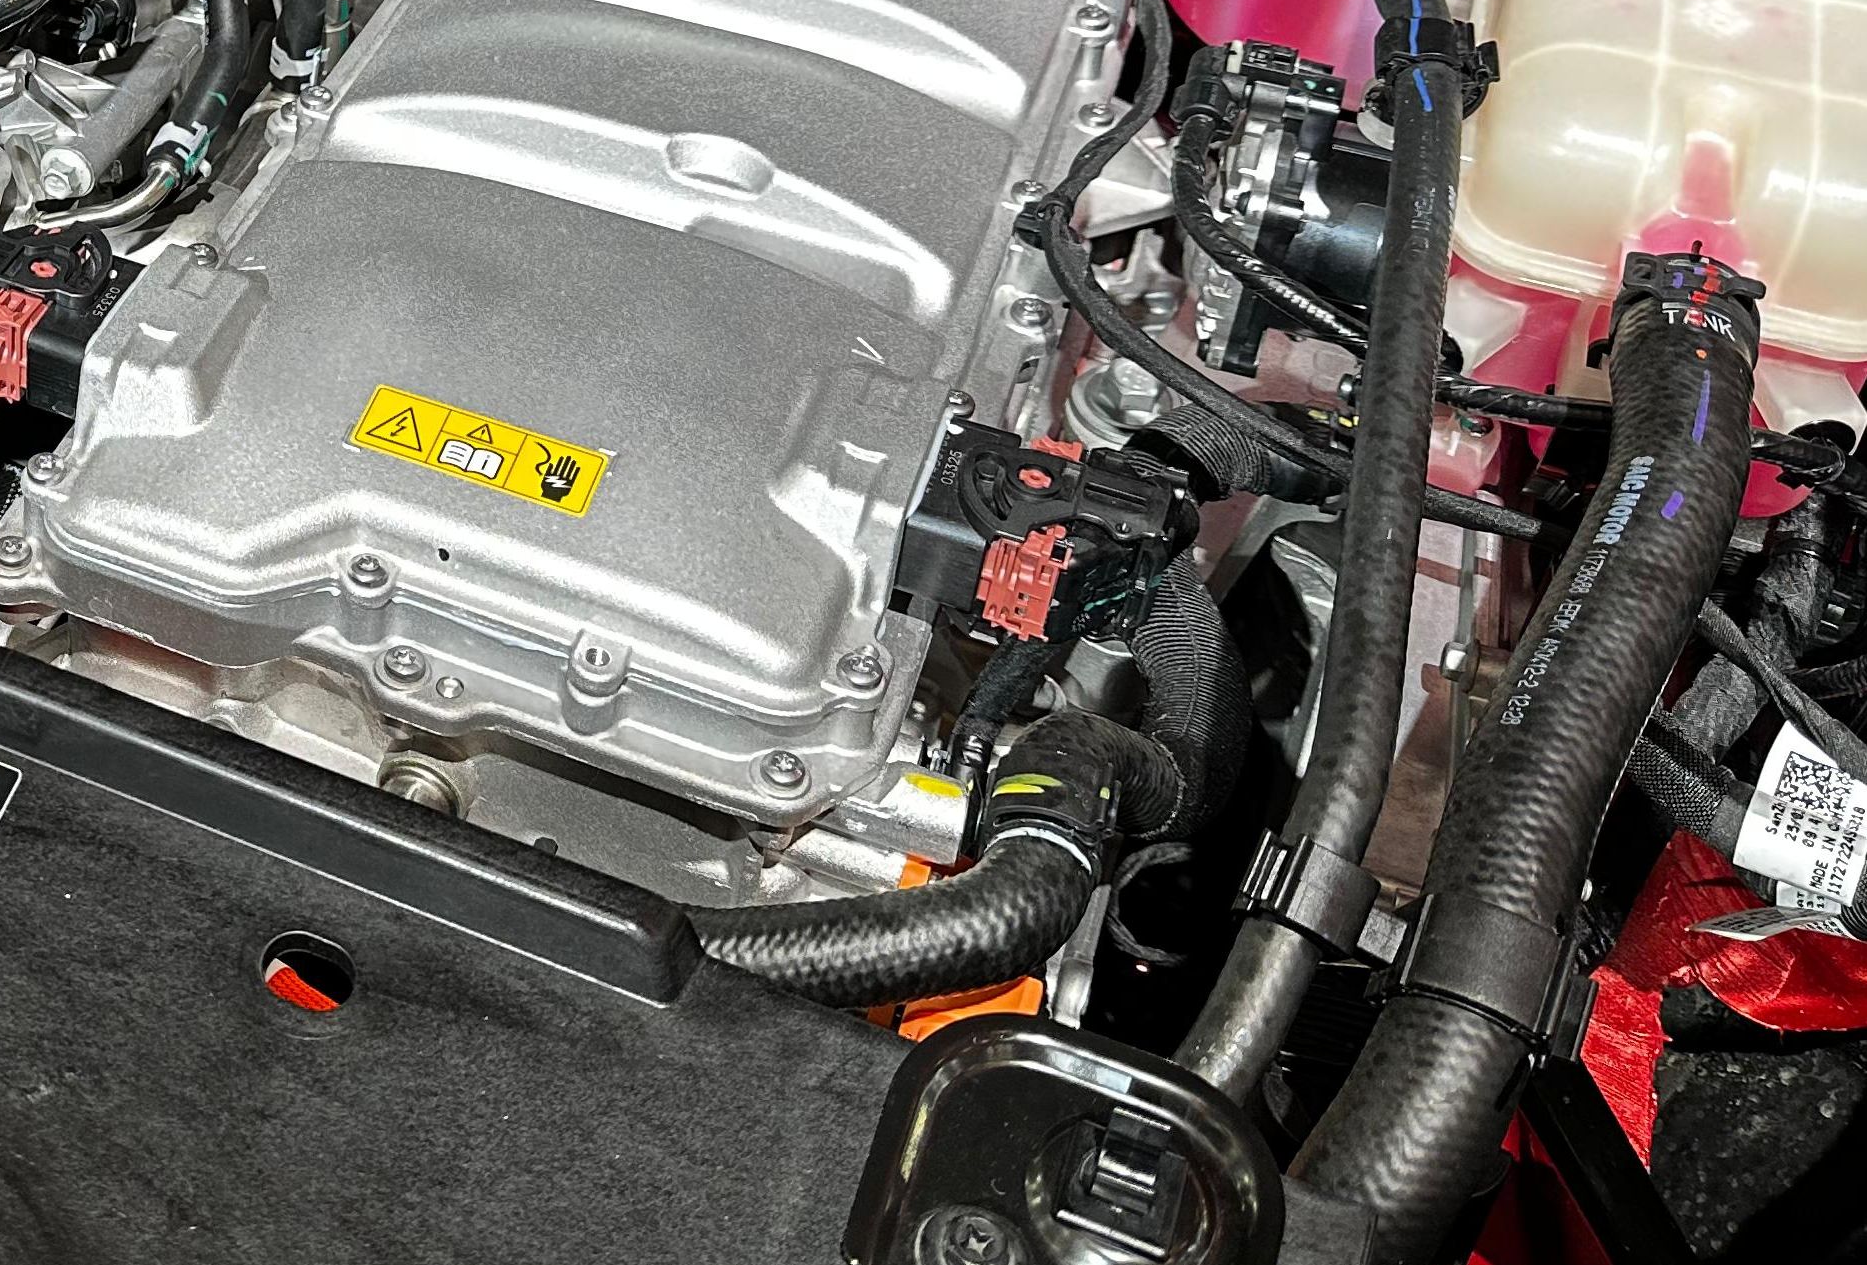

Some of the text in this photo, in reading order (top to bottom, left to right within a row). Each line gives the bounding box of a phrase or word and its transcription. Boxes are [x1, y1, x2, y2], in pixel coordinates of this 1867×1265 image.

[92, 286, 121, 317] 03325
[940, 449, 963, 485] 03325
[1619, 456, 1655, 491] SAIC
[1592, 492, 1641, 545] MOTOR
[1808, 859, 1829, 890] MADE
[1821, 835, 1837, 853] IN
